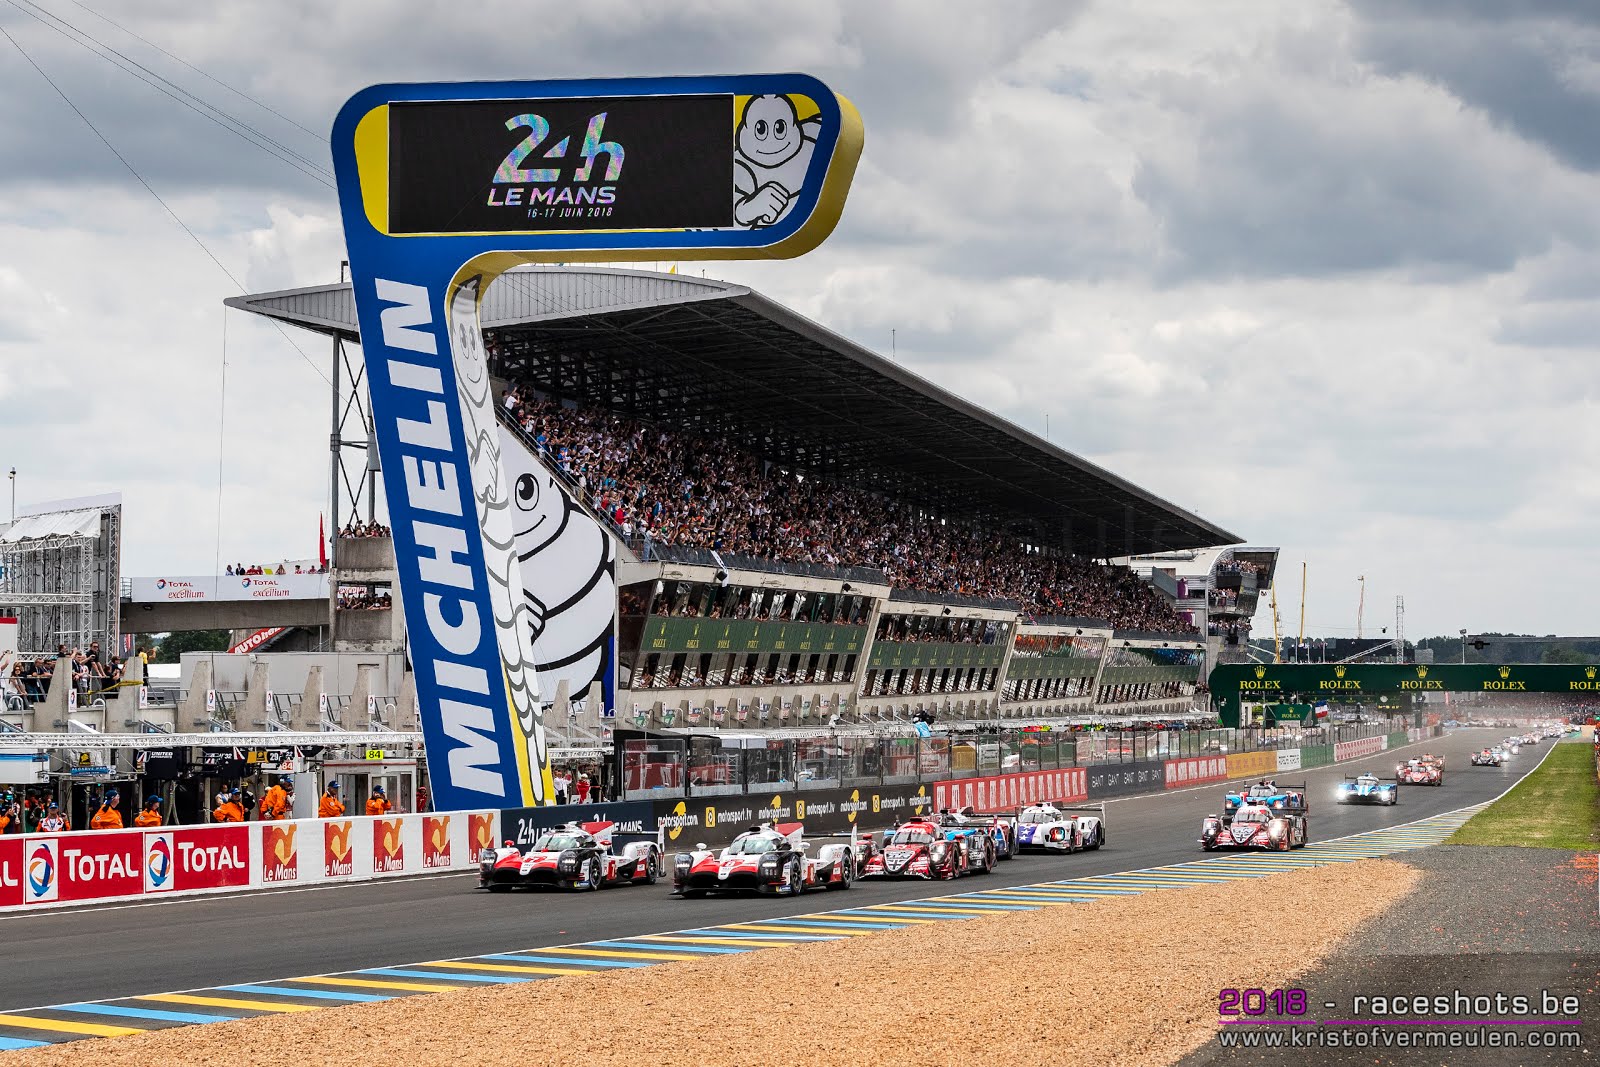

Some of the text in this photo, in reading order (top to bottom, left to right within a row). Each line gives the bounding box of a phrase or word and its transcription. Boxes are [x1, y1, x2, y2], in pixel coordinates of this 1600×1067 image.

[493, 112, 625, 183] 24h
[487, 186, 617, 206] LE MANS
[527, 207, 613, 218] 16-17 JUIN 2018
[375, 278, 505, 798] MICHELIN
[1239, 680, 1281, 690] ROLEX
[1319, 680, 1361, 690] ROLEX
[1401, 680, 1443, 690] ROLEX
[1483, 681, 1526, 690] ROLEX
[1569, 681, 1600, 690] ROLE
[368, 750, 381, 759] 84
[517, 818, 535, 845] 24h
[620, 820, 643, 832] MANS
[178, 842, 245, 873] TOTAL
[375, 855, 403, 872] Le Mans
[423, 851, 450, 867] Le Mans
[469, 849, 477, 863] Le
[64, 849, 139, 882] TOTAL
[263, 864, 296, 881] Le Mans
[331, 860, 352, 875] Mans
